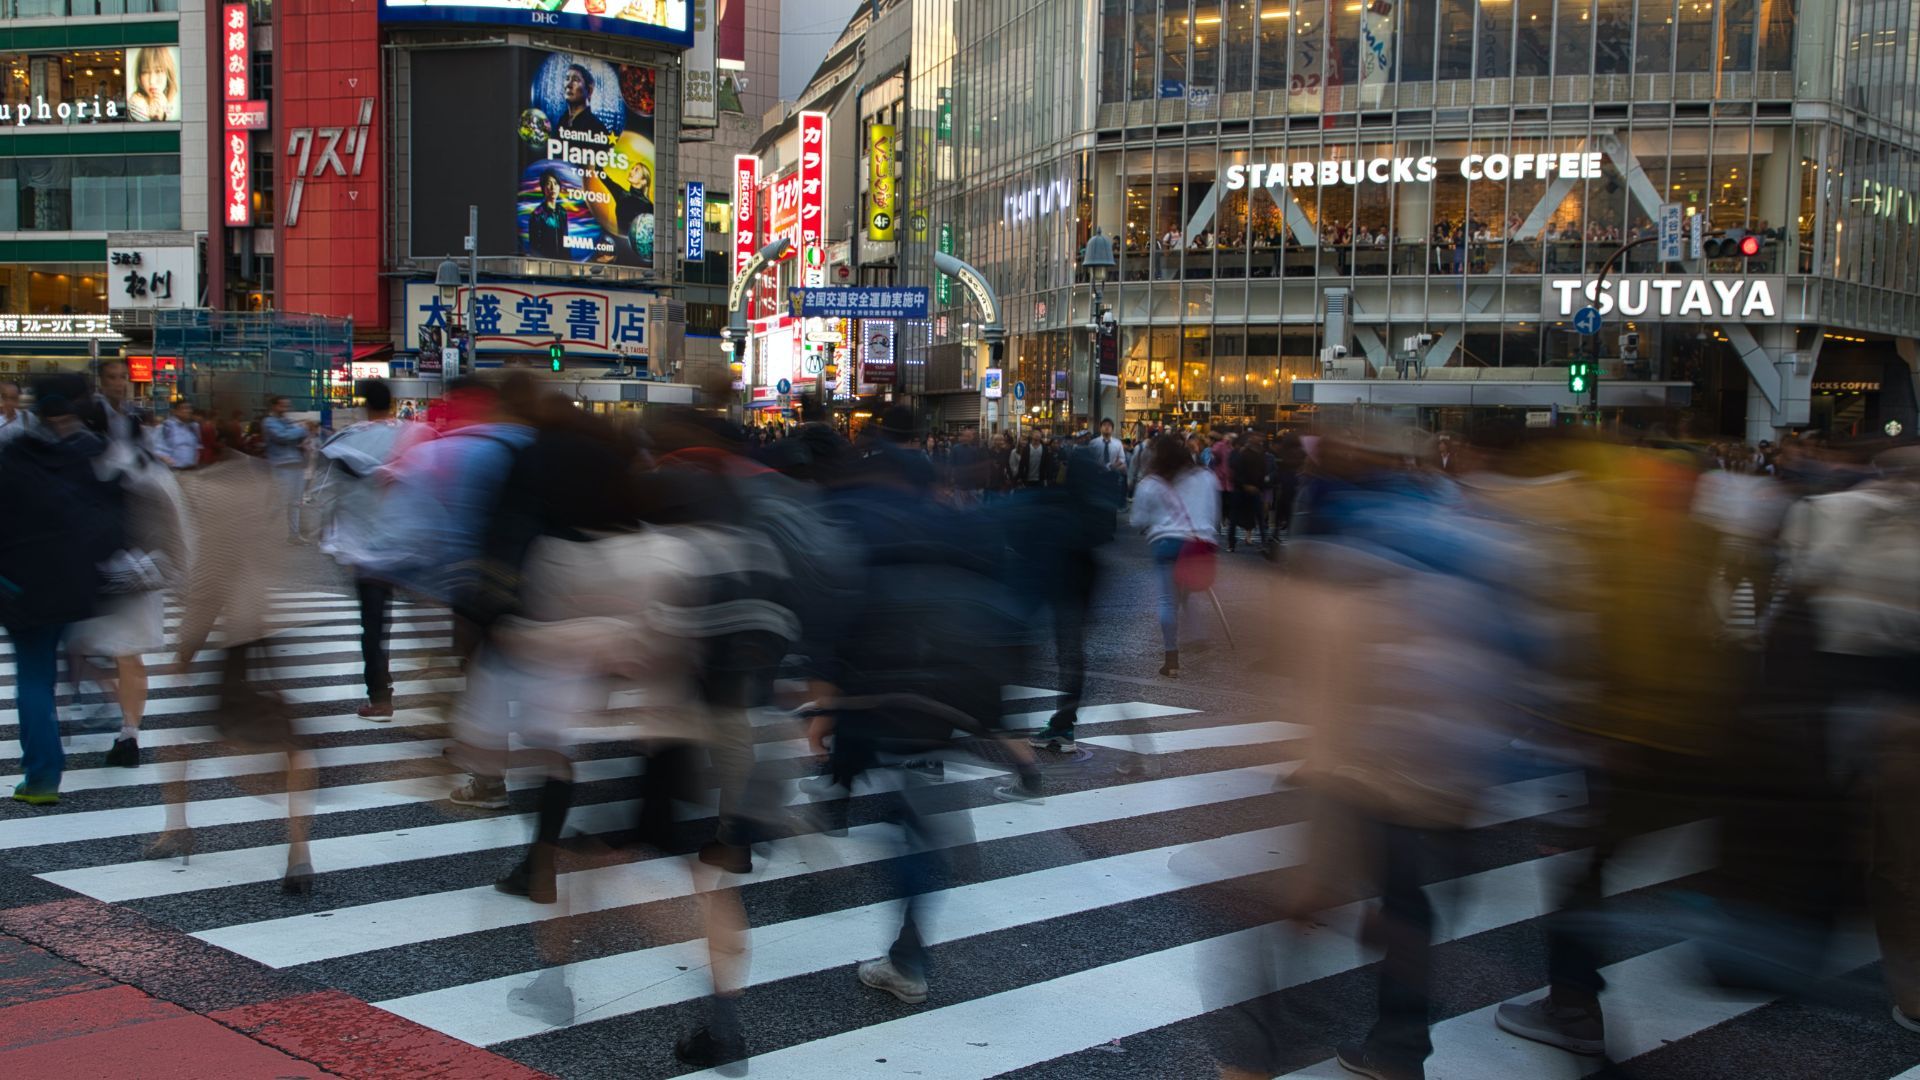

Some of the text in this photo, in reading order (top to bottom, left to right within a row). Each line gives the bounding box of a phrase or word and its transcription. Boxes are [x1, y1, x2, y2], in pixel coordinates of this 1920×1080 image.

[531, 12, 559, 25] DHC
[559, 126, 608, 145] teamLab
[285, 97, 374, 226] クスリ
[547, 138, 629, 170] Planets
[571, 168, 607, 179] TOKYO
[802, 127, 821, 220] カラオケ
[1226, 152, 1602, 190] STARBUCKS COFFEE
[567, 188, 611, 204] TOYOSU
[689, 186, 700, 257] 大盛堂商事ビル
[874, 215, 889, 228] 4F
[124, 269, 172, 299] 松川
[1552, 279, 1776, 316] TSUTAYA
[805, 291, 925, 308] 全国交通安全運動実施中
[419, 294, 645, 344] 大盛堂書店
[1840, 382, 1881, 390] COFFEE
